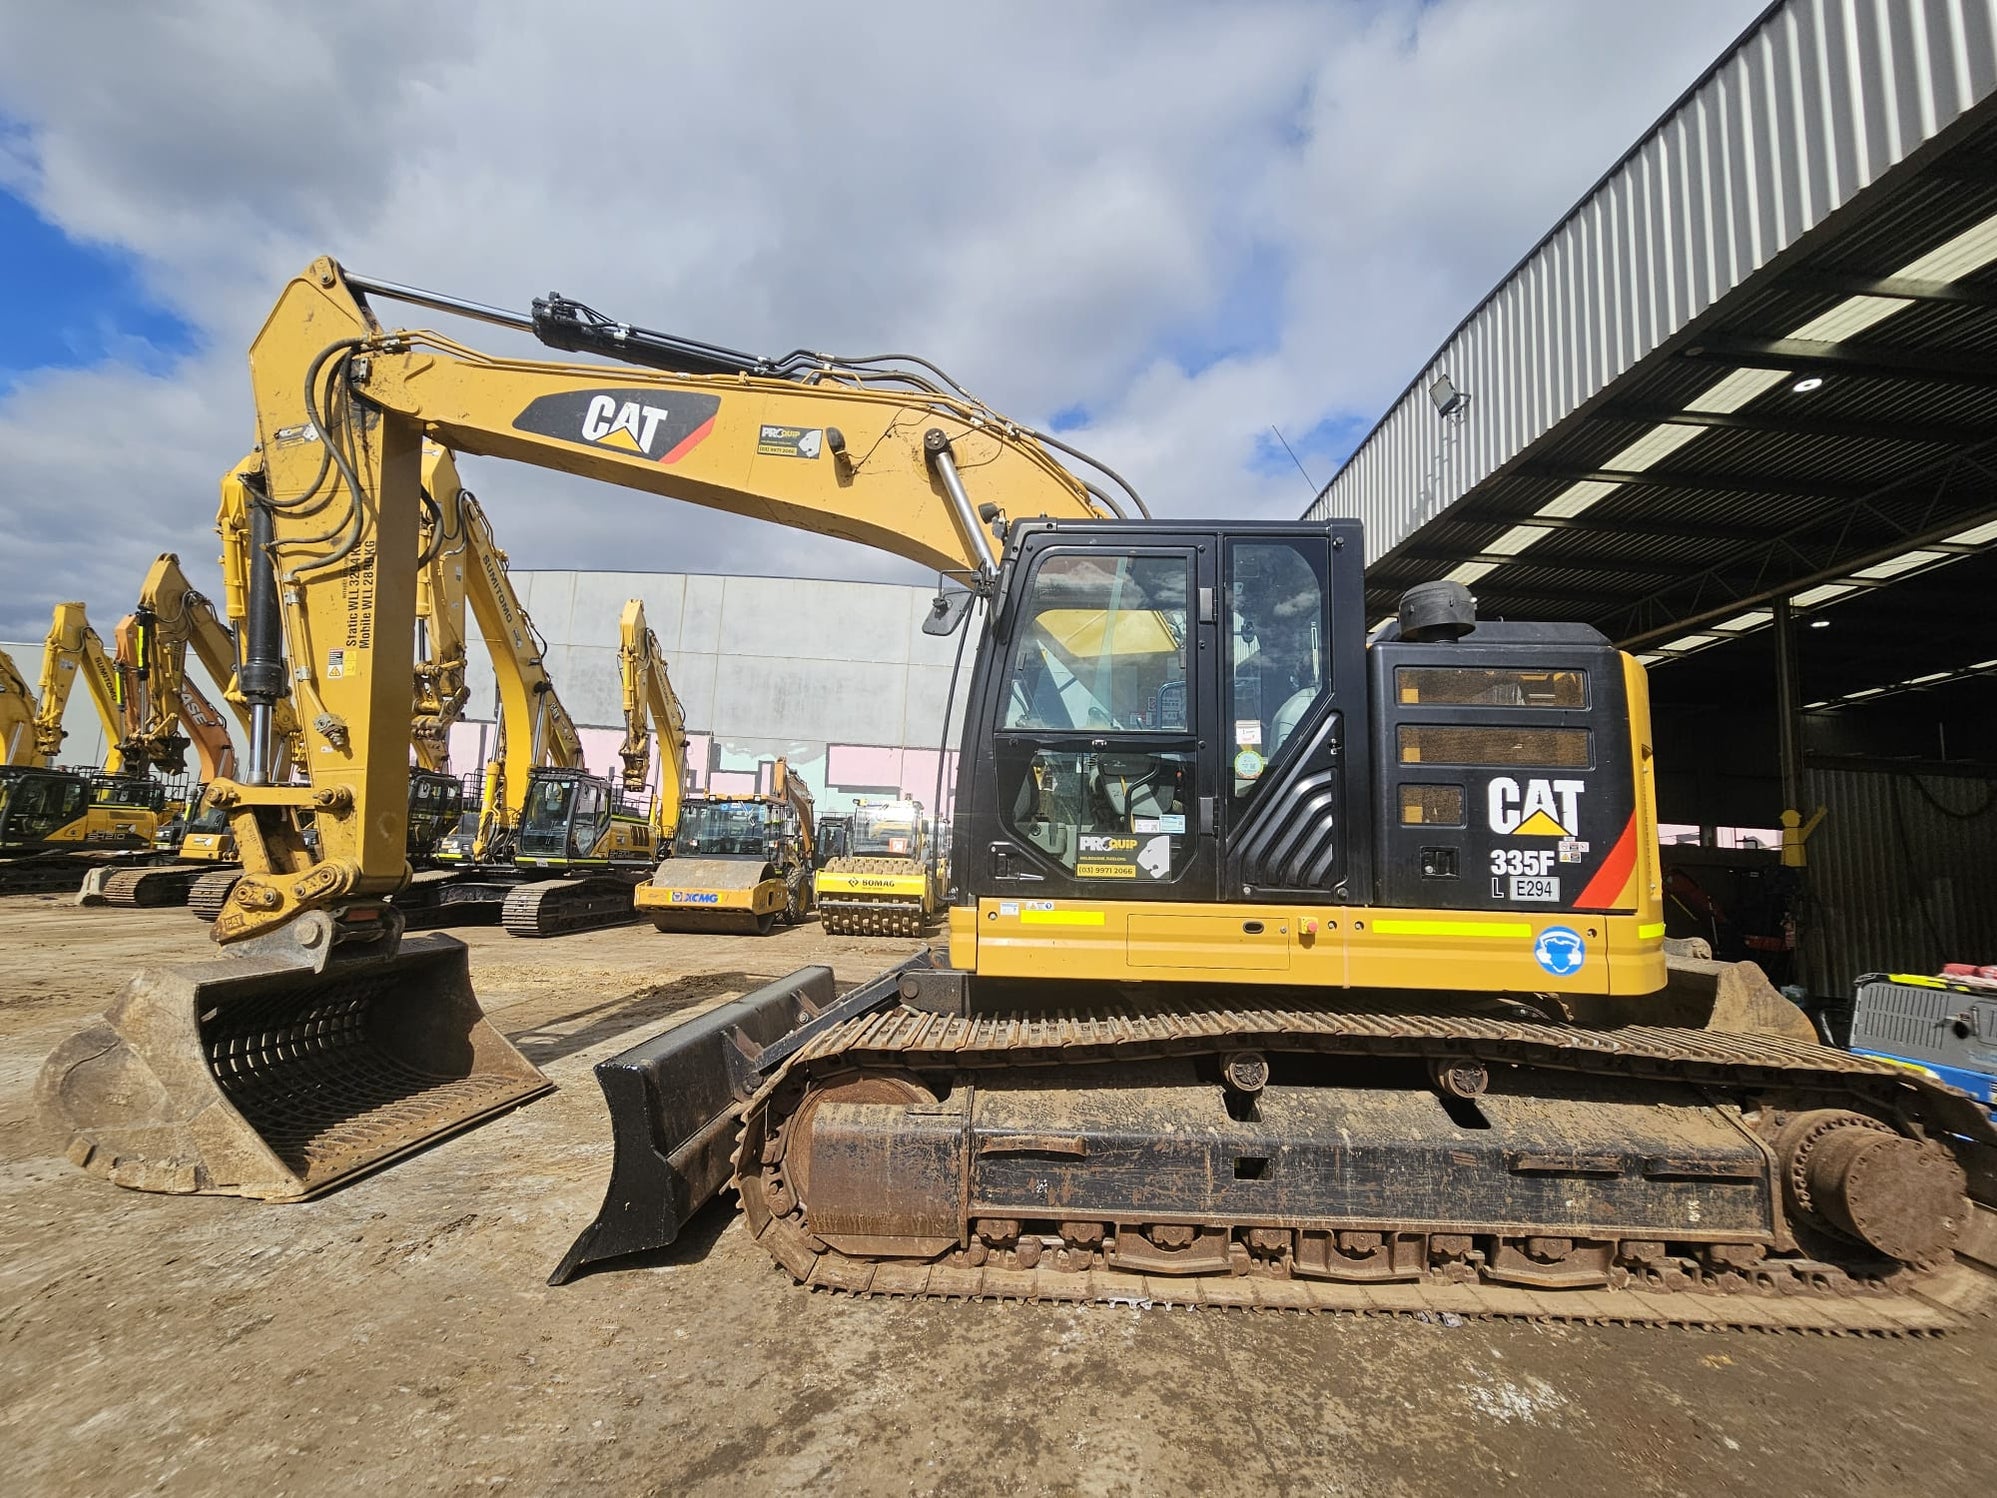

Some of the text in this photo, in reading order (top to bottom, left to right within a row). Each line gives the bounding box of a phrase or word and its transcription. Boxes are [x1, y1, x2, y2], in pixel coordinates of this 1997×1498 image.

[582, 395, 668, 454] CAT
[364, 540, 375, 555] KG
[348, 588, 359, 611] WLL
[362, 587, 373, 610] WLL
[482, 554, 513, 623] SUMITOMO
[346, 612, 358, 647] Static
[359, 612, 371, 649] Mobile
[1488, 776, 1584, 837] CAT
[1079, 836, 1138, 851] PROQUIP
[1078, 865, 1133, 875] (03) 9971 2066
[1490, 849, 1555, 876] 335F
[861, 879, 895, 888] BOMAG
[1491, 877, 1505, 899] L
[1516, 880, 1553, 897] E294
[683, 893, 719, 904] XCMG
